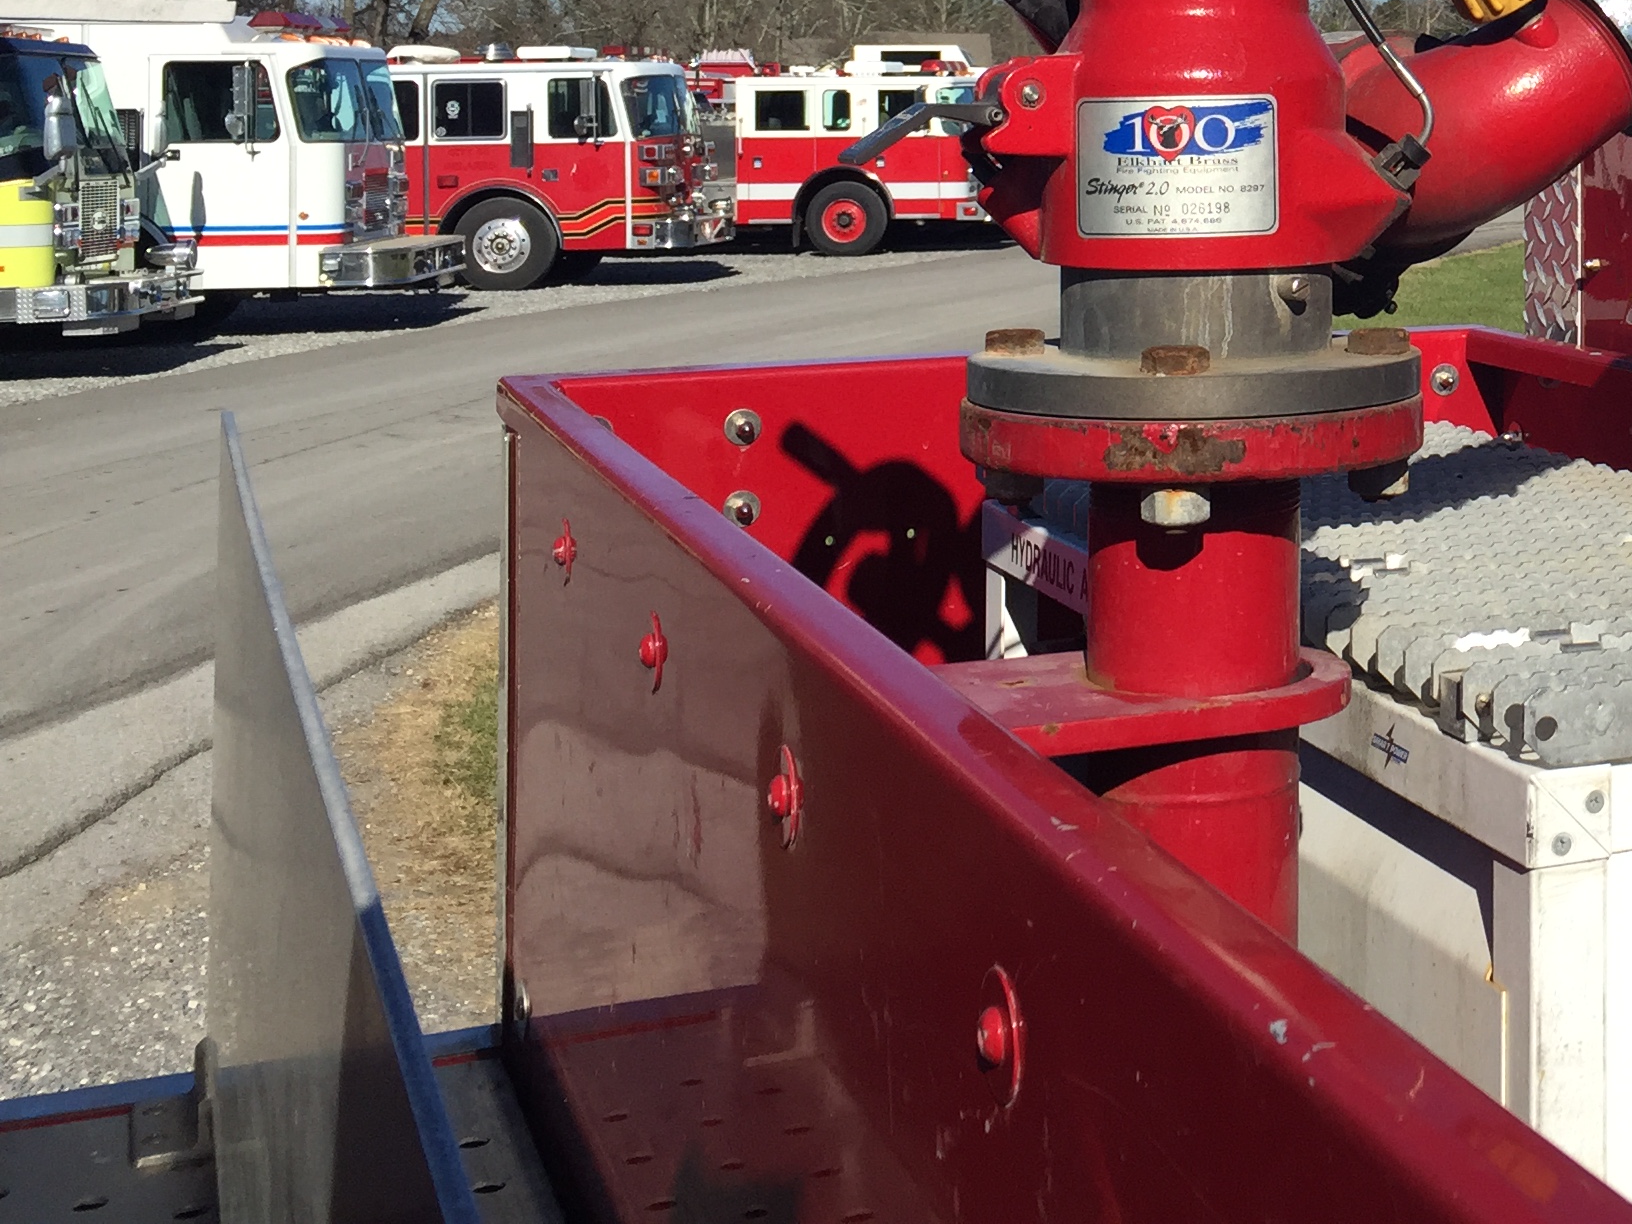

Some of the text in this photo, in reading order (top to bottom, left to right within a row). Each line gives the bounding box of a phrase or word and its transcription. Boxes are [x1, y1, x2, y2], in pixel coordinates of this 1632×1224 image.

[1126, 114, 1236, 153] 100
[1117, 156, 1239, 166] Elkhart Brass
[1137, 167, 1179, 175] Fighting
[1183, 166, 1239, 174] Equipment
[1145, 181, 1169, 195] 2.0
[1175, 186, 1215, 194] MODEL
[1113, 205, 1148, 214] SERIAL
[1181, 201, 1231, 215] 026198
[1011, 533, 1075, 595] HYDRAULIC
